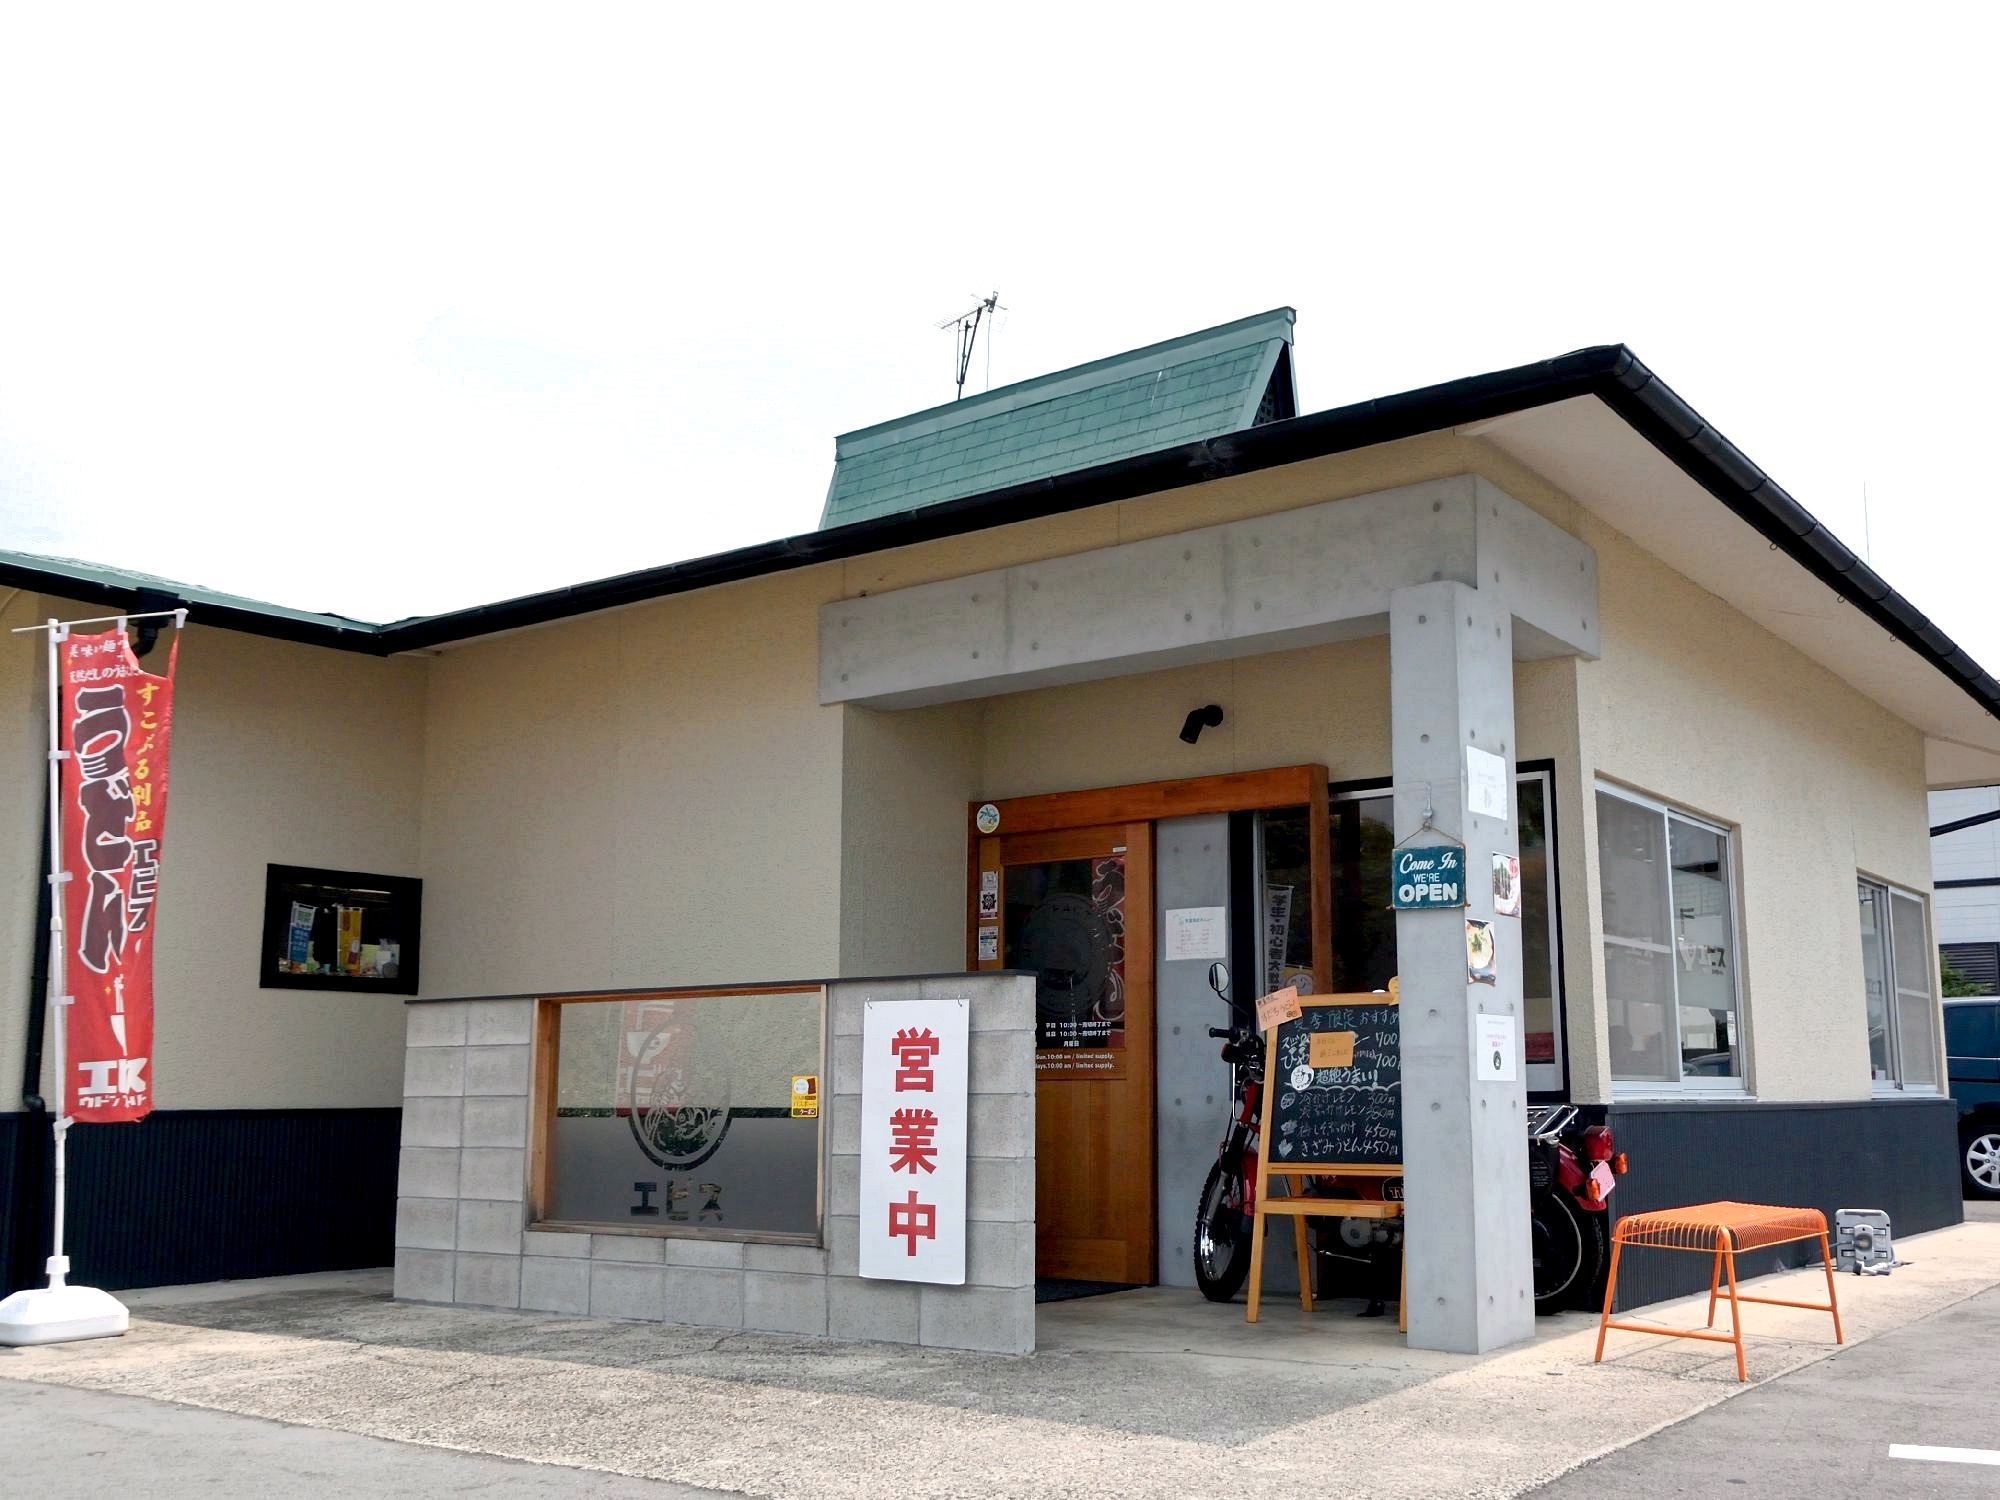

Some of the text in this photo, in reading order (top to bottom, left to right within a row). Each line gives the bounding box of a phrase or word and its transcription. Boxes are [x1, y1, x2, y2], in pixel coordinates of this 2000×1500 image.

[1400, 852, 1458, 874] Come In
[1413, 872, 1440, 883] WE'RE
[1398, 883, 1458, 902] OPEN
[888, 1026, 940, 1257] 営業中
